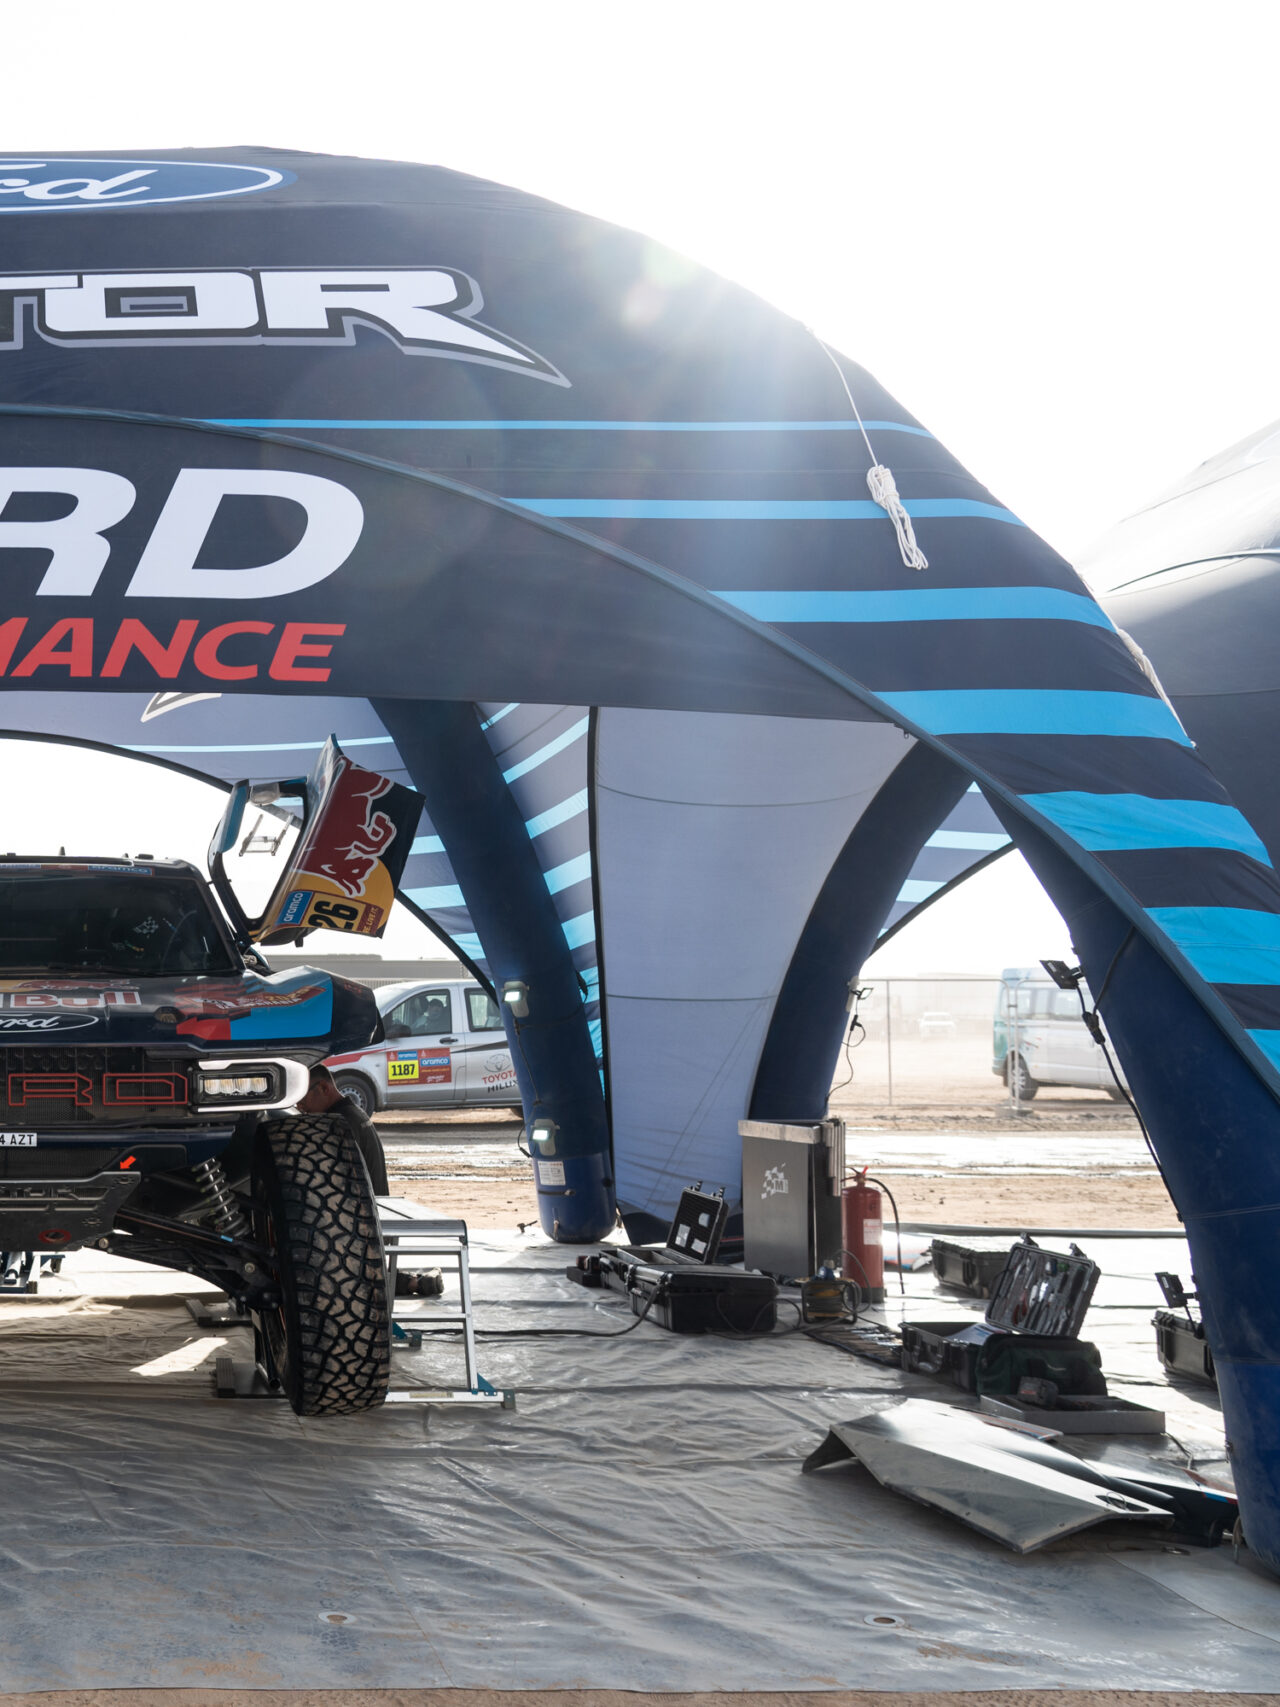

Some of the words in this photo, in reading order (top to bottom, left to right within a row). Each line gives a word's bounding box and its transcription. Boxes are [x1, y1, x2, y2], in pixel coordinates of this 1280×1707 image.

[283, 892, 304, 922] aramco
[10, 991, 142, 1009] Bull
[421, 1057, 449, 1067] aramco
[391, 1064, 415, 1077] 1187
[10, 1133, 35, 1146] AZT
